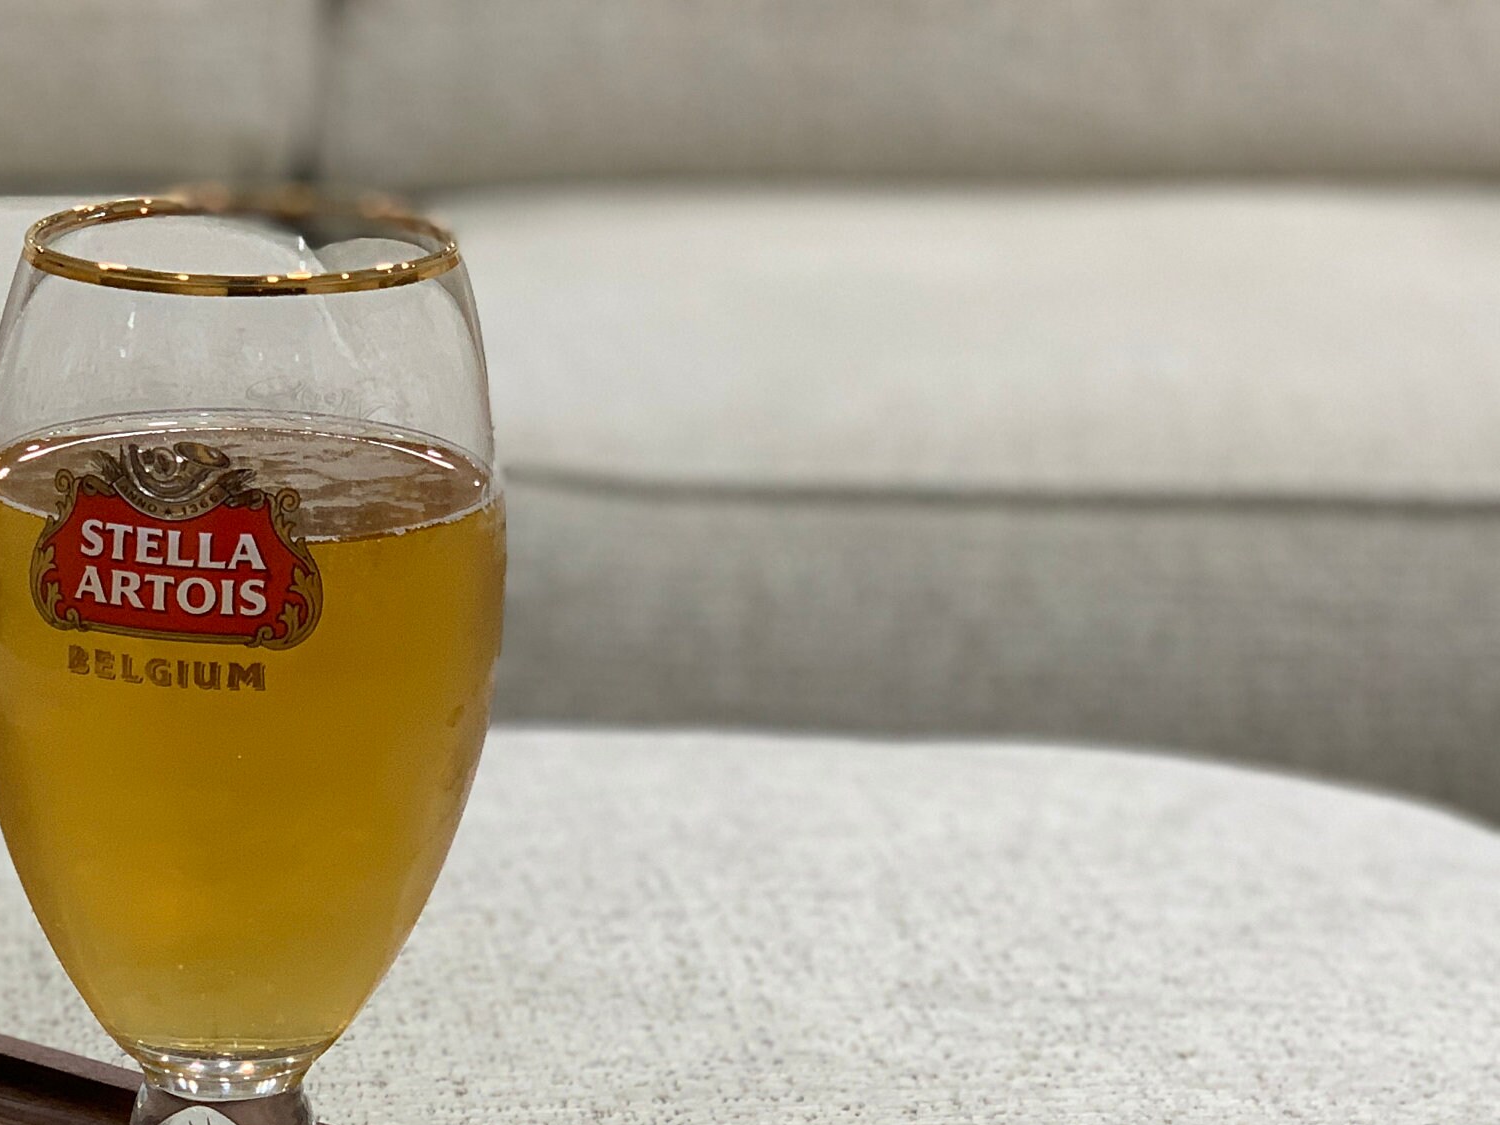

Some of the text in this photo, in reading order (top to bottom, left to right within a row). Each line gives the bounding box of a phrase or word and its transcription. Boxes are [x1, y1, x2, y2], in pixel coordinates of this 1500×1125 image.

[80, 519, 267, 571] STELLA
[74, 565, 267, 616] ARTOIS
[67, 644, 266, 691] BELGIUM
